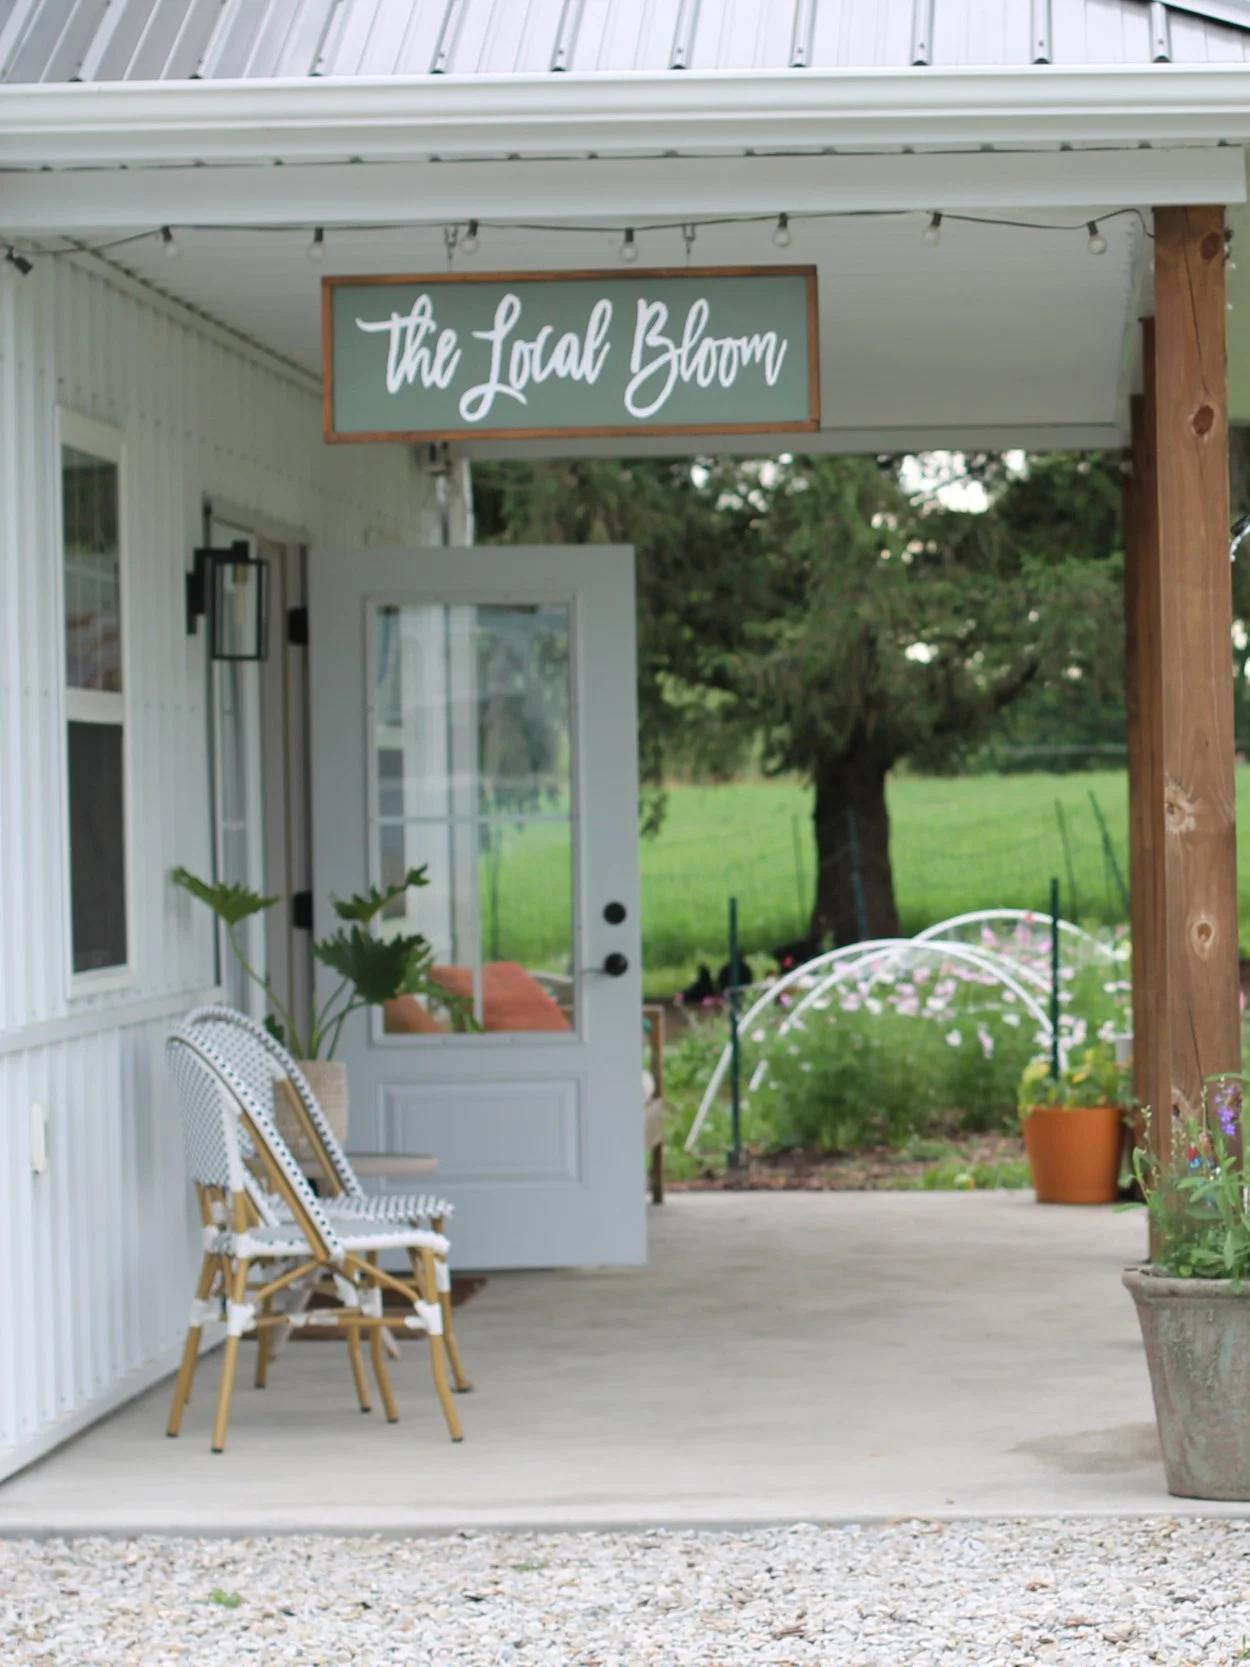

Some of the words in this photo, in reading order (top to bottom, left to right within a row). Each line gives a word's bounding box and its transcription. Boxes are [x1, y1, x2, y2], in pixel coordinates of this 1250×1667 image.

[356, 294, 462, 393] the
[459, 294, 613, 422] Local
[624, 298, 788, 418] Bloom
